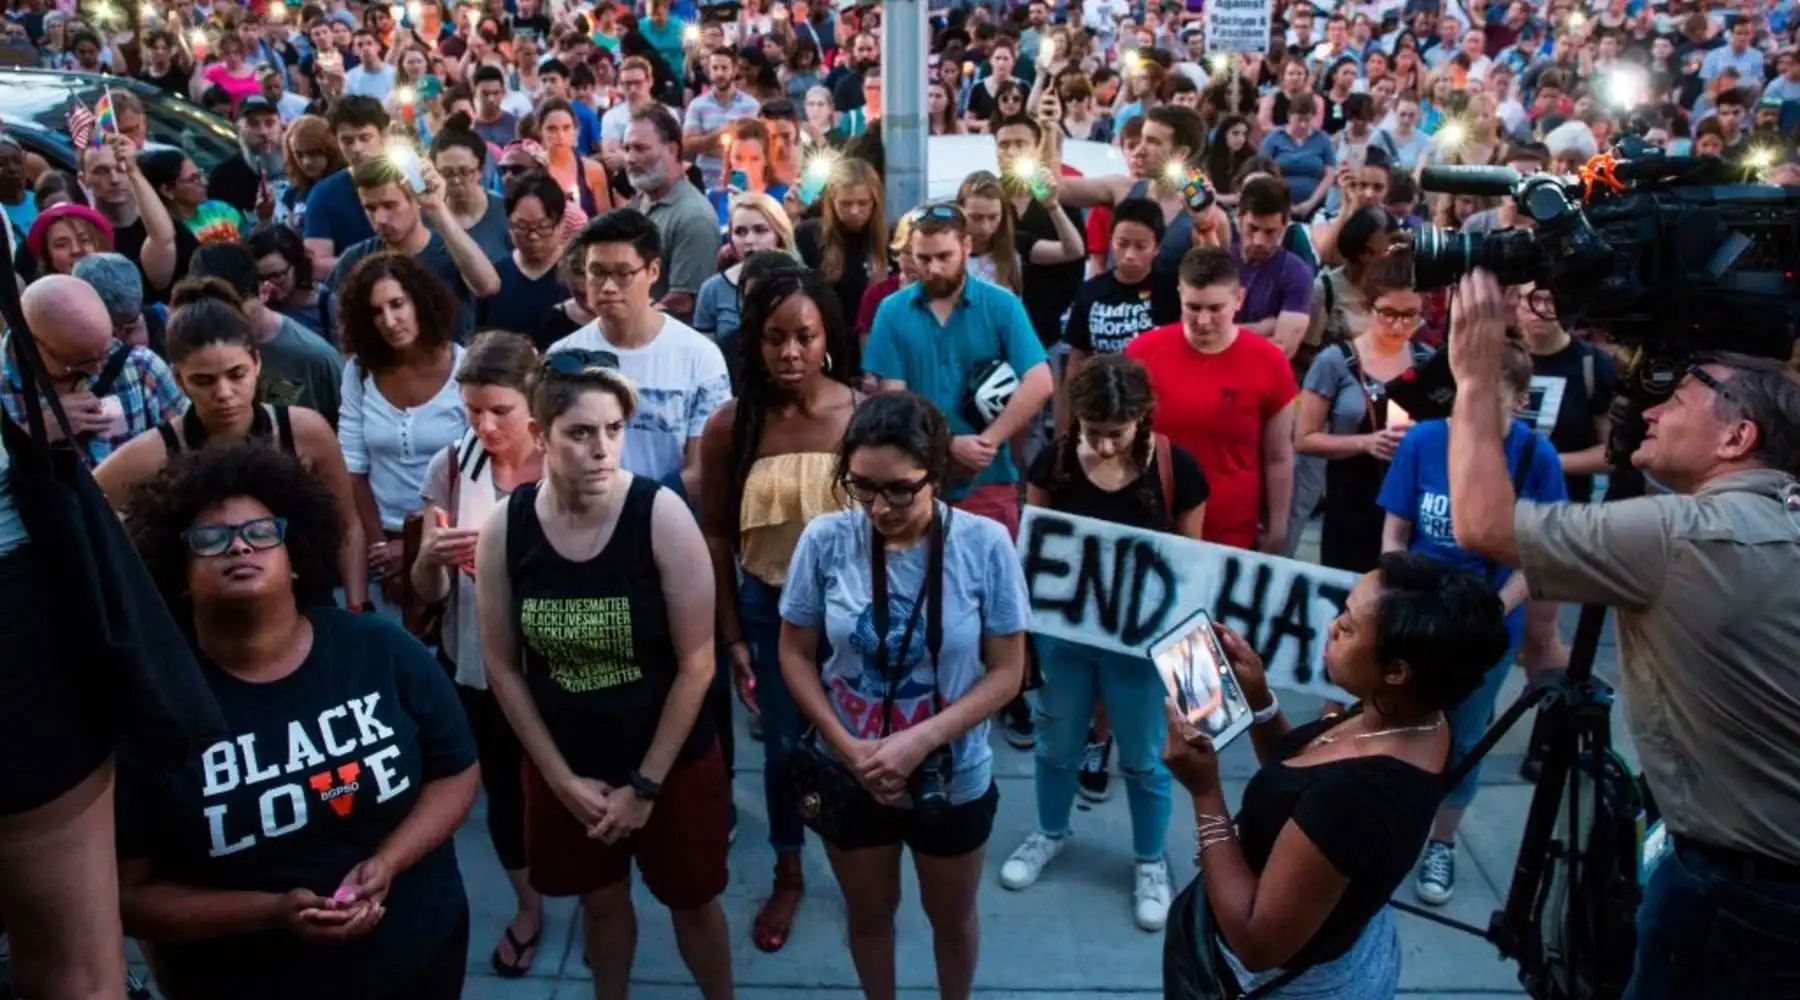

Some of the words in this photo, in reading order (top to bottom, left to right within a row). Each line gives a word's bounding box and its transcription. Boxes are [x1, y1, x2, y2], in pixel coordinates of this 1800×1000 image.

[1026, 516, 1177, 646] END
[202, 691, 395, 797] BLACK
[203, 744, 411, 858] LOVE
